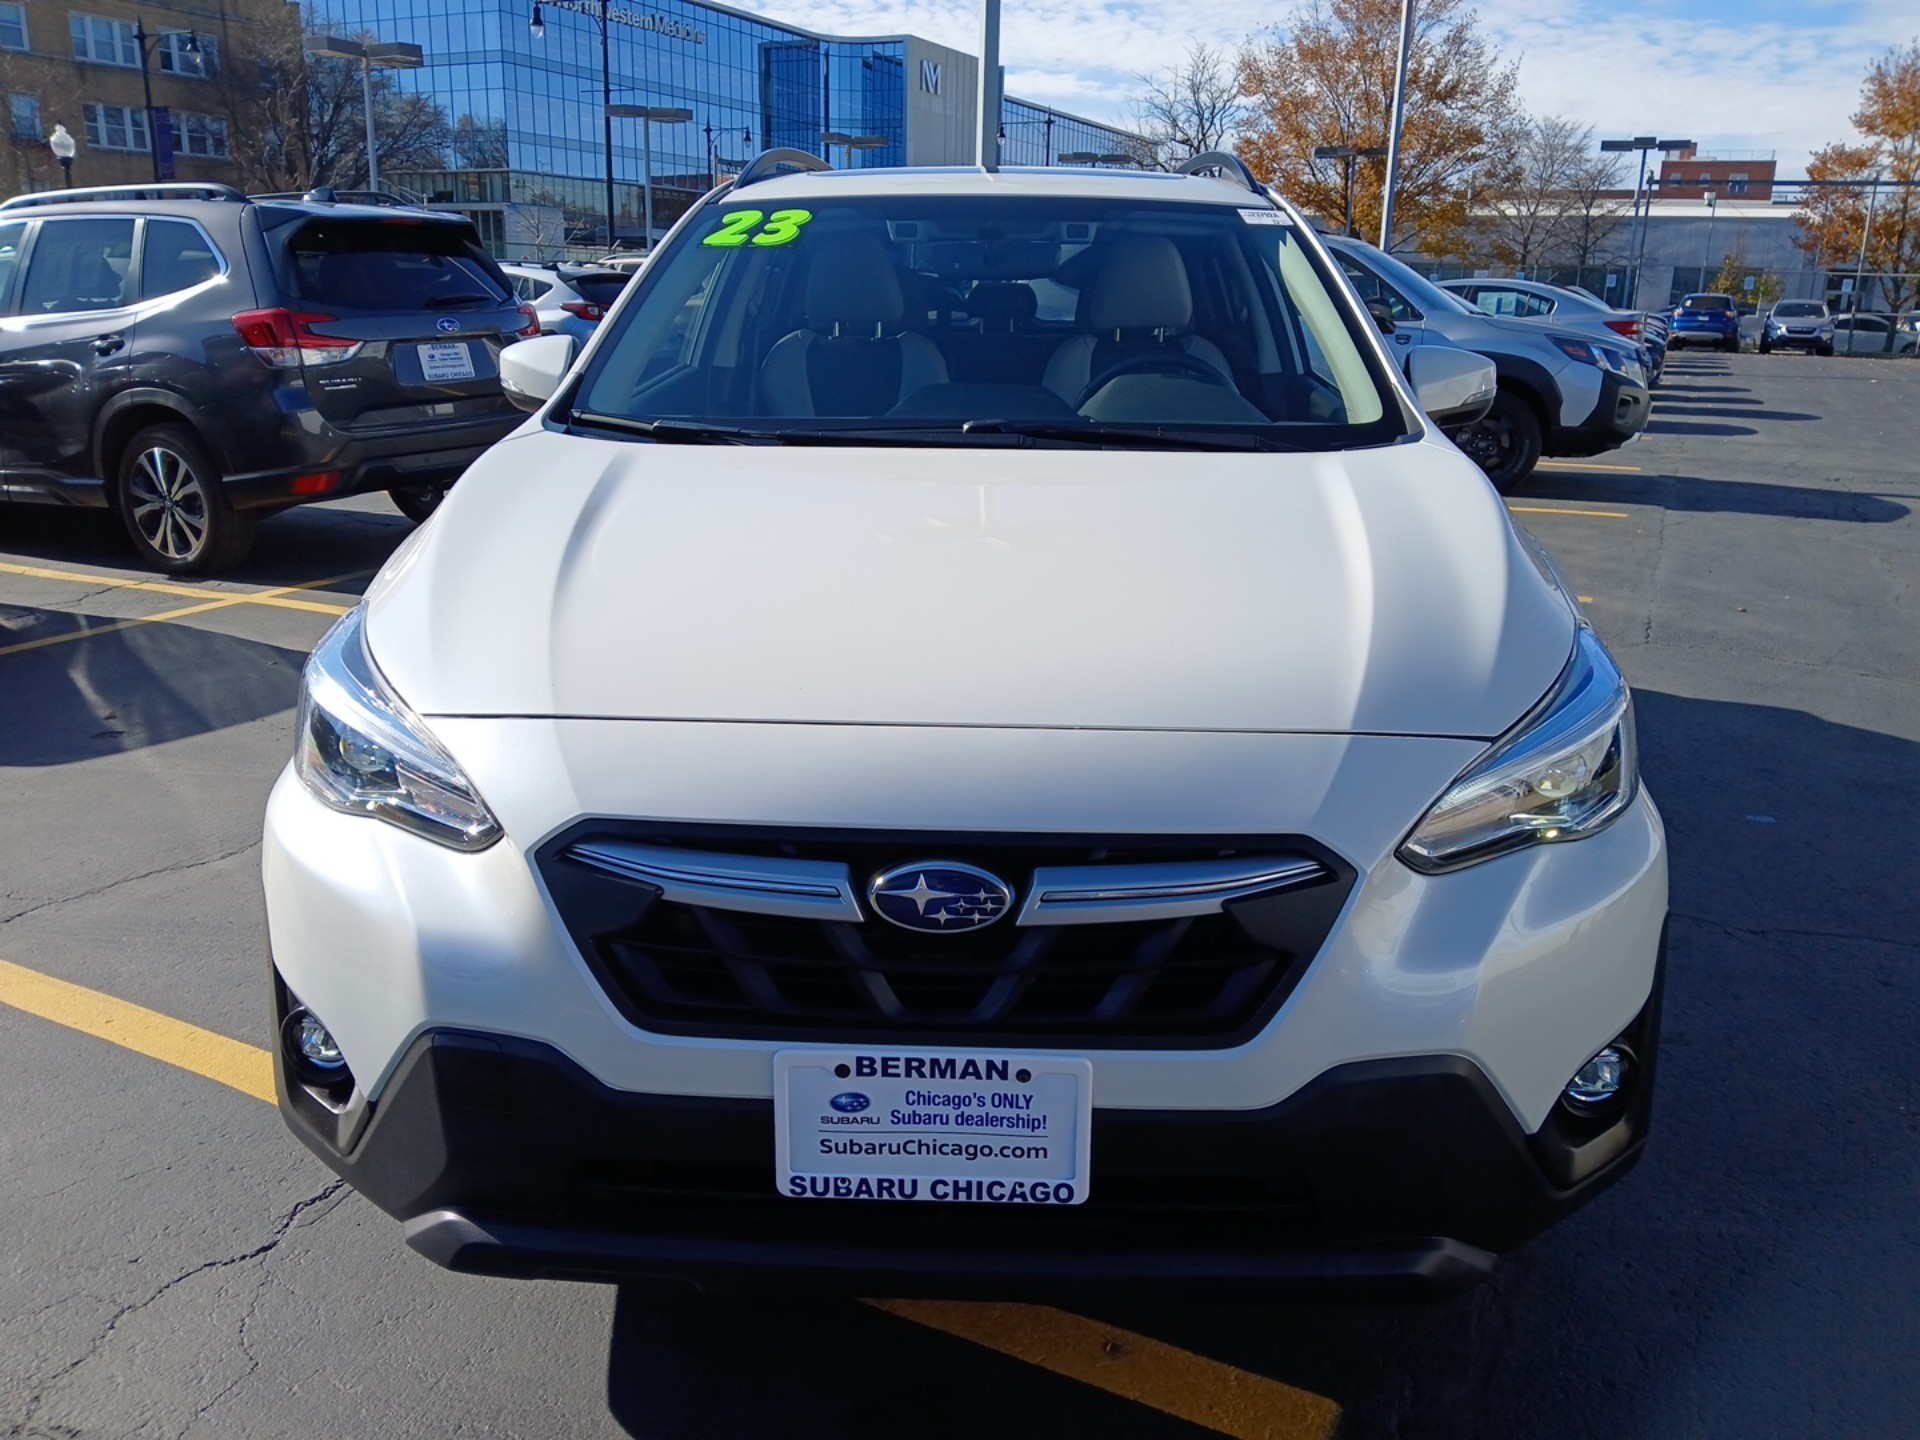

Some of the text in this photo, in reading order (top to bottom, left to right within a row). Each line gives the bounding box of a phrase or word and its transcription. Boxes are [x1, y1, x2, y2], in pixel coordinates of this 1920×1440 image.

[655, 14, 707, 45] Medicine
[702, 208, 813, 247] 23
[854, 1055, 1010, 1081] BERMAN
[904, 1090, 1034, 1111] Chicago's ONLY
[820, 1115, 881, 1126] SUBARU
[890, 1109, 1048, 1132] Subaru dealership!
[819, 1138, 1049, 1161] SubaruChicago.com
[788, 1175, 1076, 1204] SUBARU CHICAGO
